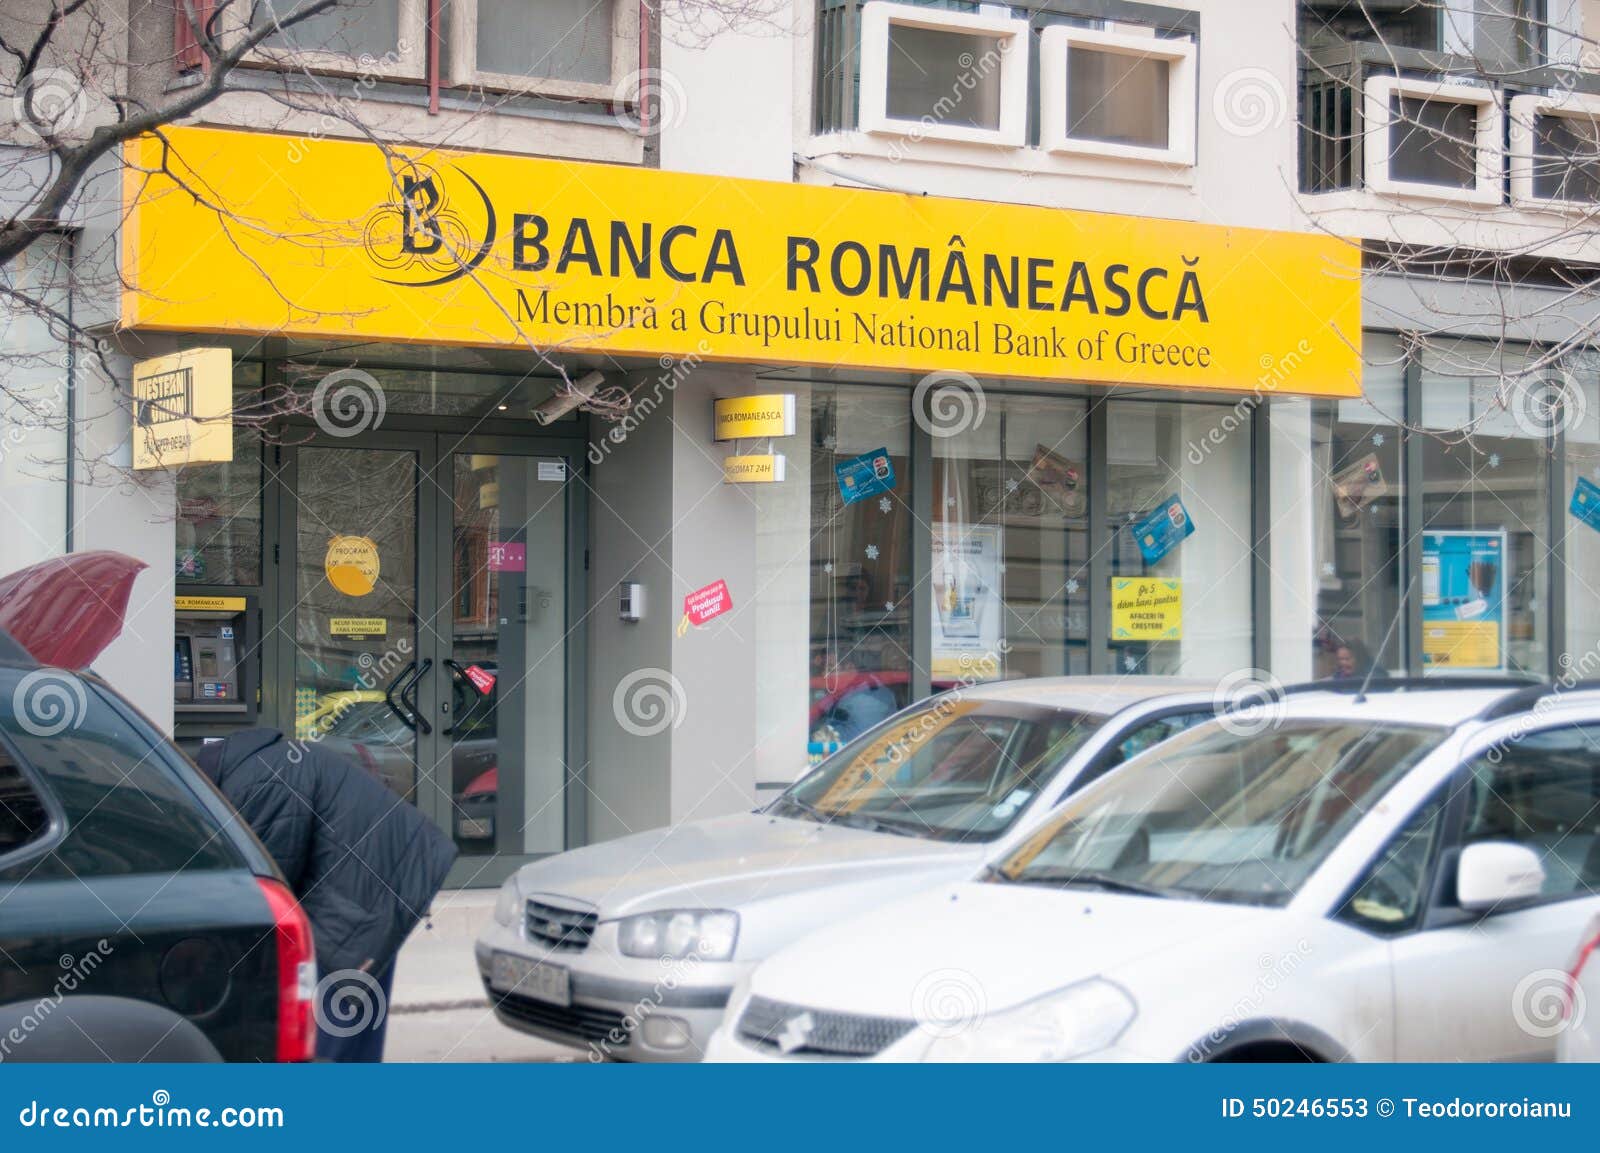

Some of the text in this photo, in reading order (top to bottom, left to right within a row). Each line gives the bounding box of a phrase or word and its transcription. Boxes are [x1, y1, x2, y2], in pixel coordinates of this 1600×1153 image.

[512, 213, 1210, 323] BANCA ROMÂNEASCĂ
[515, 288, 1211, 368] Membră a Grupului National Bank of Greece
[755, 464, 771, 473] 24H
